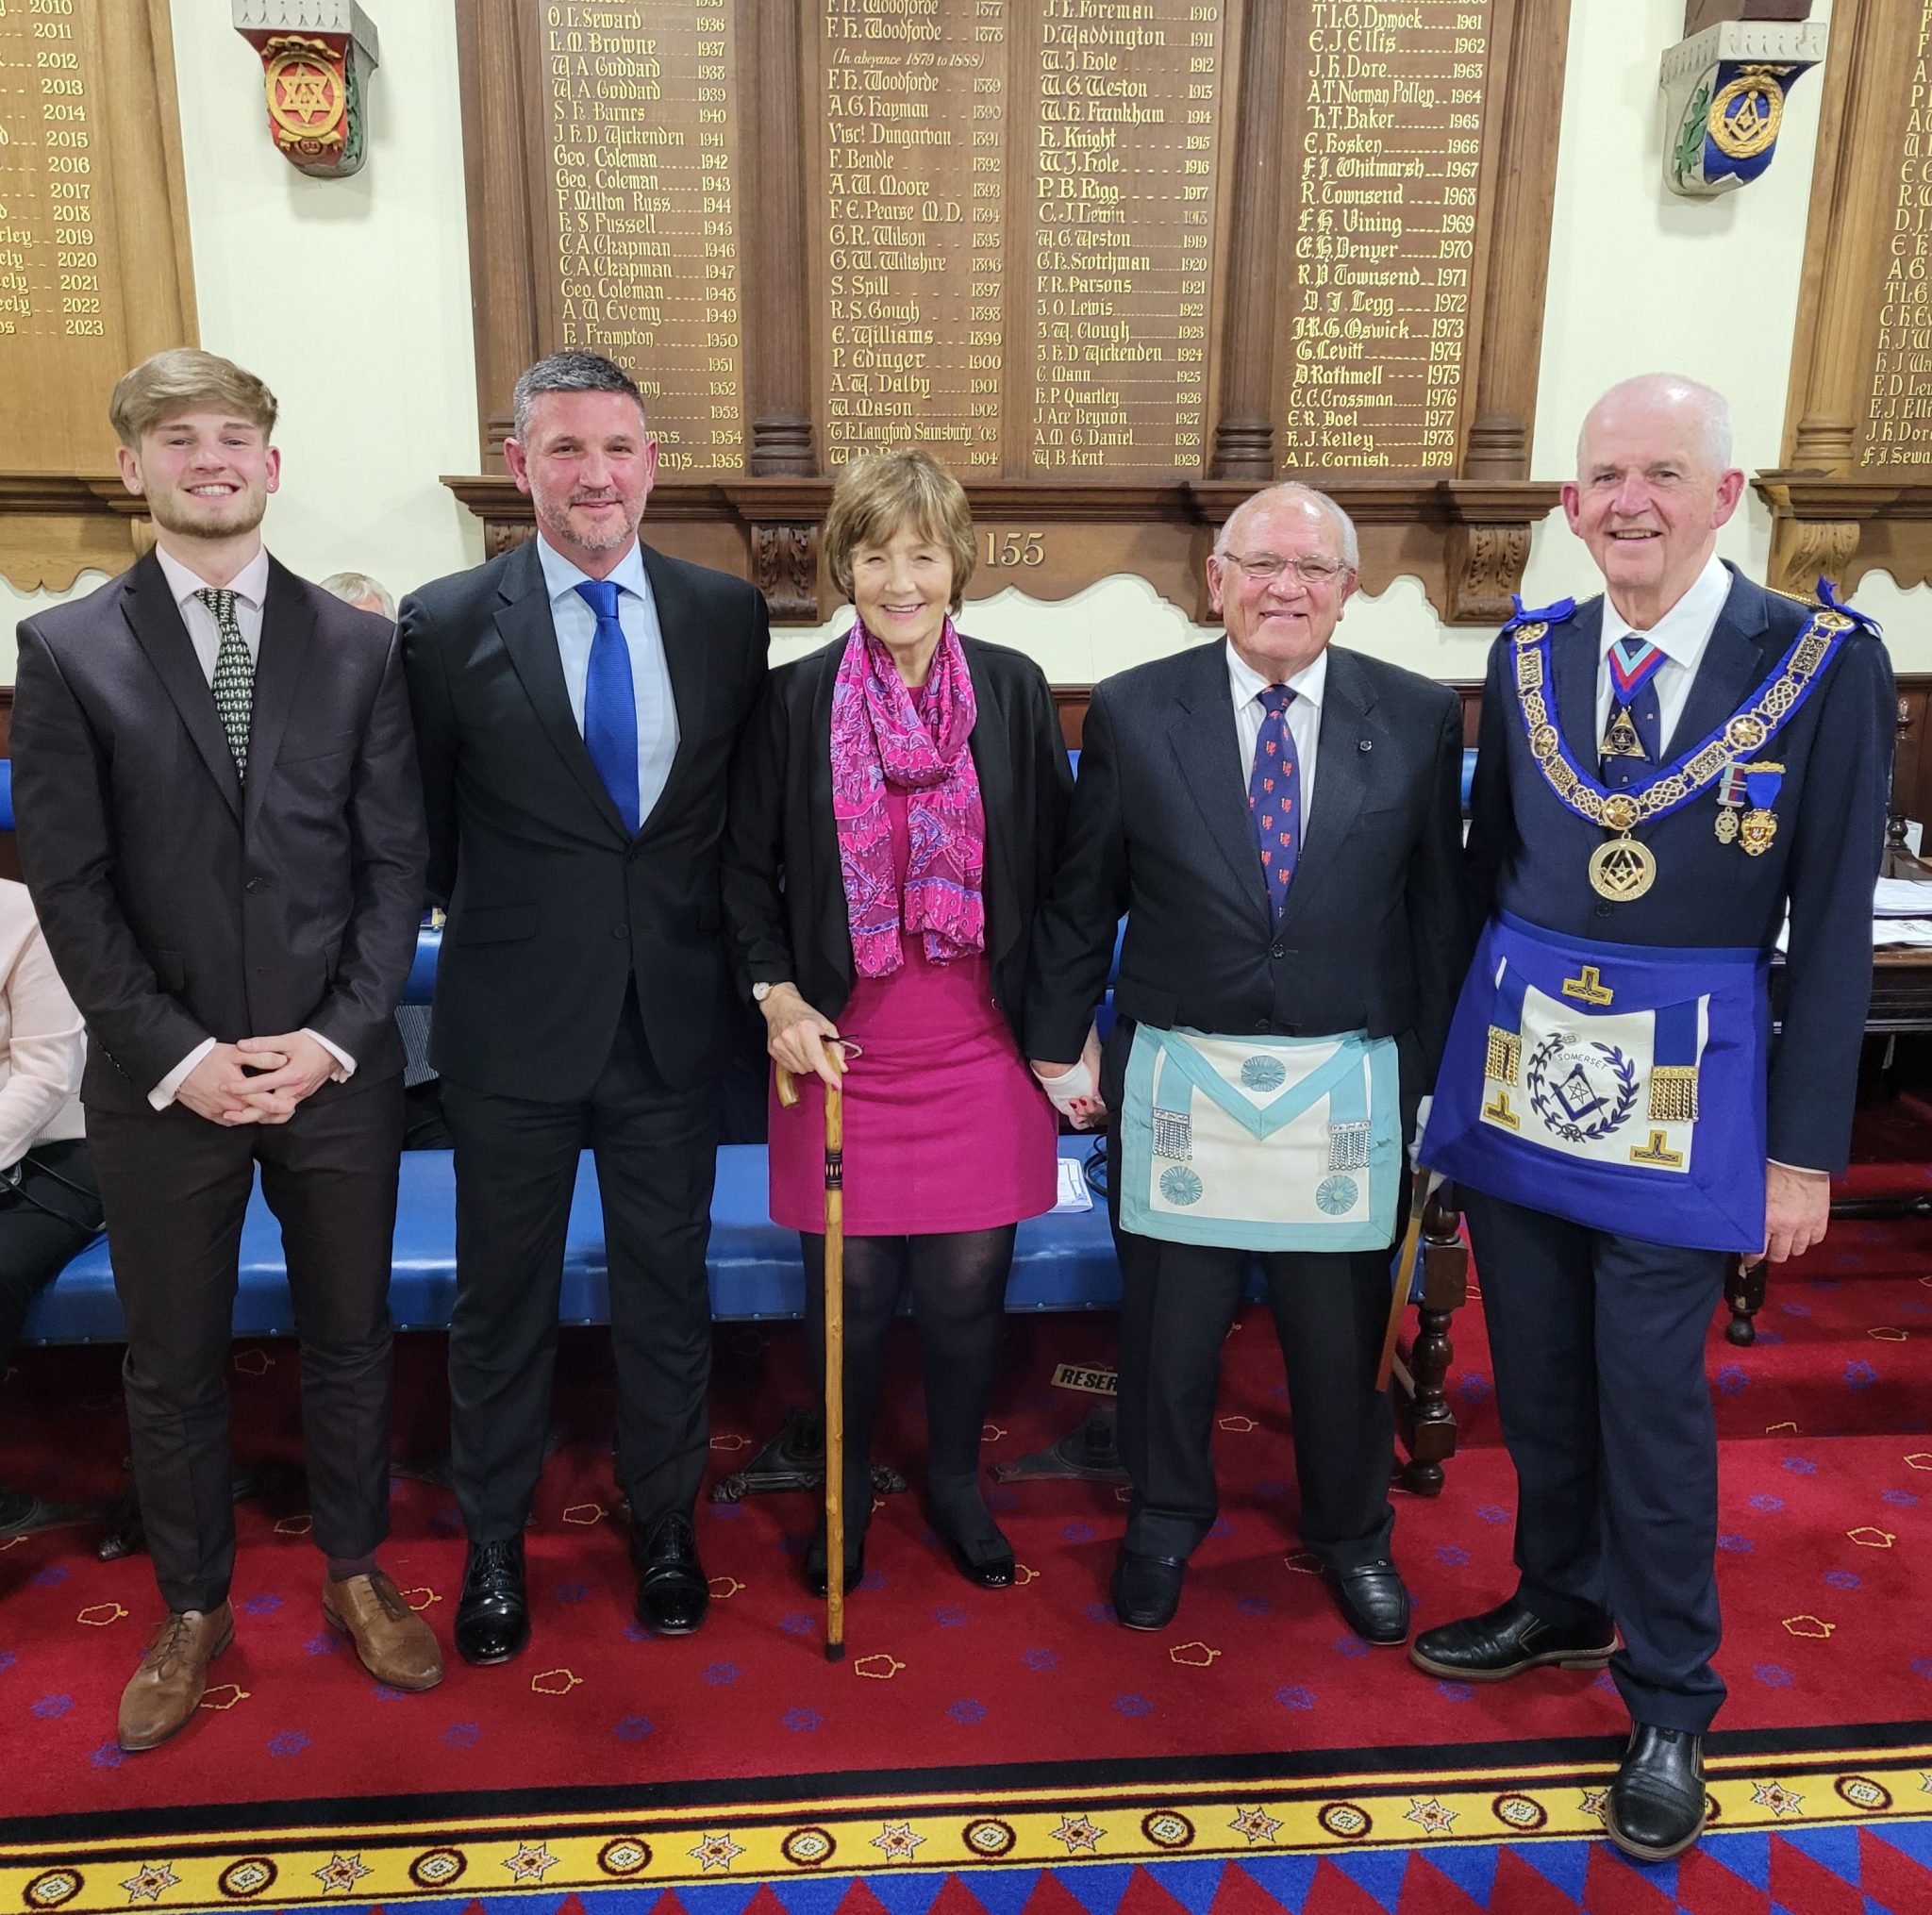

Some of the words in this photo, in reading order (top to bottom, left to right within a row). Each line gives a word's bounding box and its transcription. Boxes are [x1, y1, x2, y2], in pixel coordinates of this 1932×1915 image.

[30, 0, 73, 15] 2010
[975, 2, 1003, 16] 1877
[1190, 7, 1217, 21] 1910
[696, 18, 724, 31] 1936
[1456, 15, 1482, 29] 1961
[34, 24, 73, 39] 2011
[865, 18, 941, 43] Woodforde
[975, 26, 1003, 42] 1878
[1191, 33, 1213, 46] 1911
[1454, 39, 1485, 53] 1962
[697, 42, 725, 57] 1937
[37, 53, 78, 69] 2012
[855, 50, 901, 68] abeyance
[907, 53, 934, 65] 1879
[938, 56, 946, 65] to
[1190, 58, 1214, 73] 1912
[595, 57, 660, 77] Goddard
[698, 66, 725, 79] 1938
[1453, 64, 1483, 78] 1963
[42, 79, 84, 94] 2013
[864, 70, 939, 94] Woodforde
[974, 78, 1001, 92] 1889
[1086, 75, 1147, 97] Weston
[1189, 85, 1213, 99] 1913
[698, 88, 726, 102] 1939
[1451, 90, 1481, 104] 1964
[43, 105, 85, 121] 2014
[593, 102, 645, 121] Barnes
[699, 109, 726, 124] 1940
[973, 106, 1001, 119] 1890
[1088, 102, 1164, 127] Frankham
[1188, 111, 1211, 124] 1914
[1449, 114, 1479, 129] 1965
[46, 131, 88, 147] 2015
[605, 125, 684, 149] Wickenden
[700, 133, 724, 147] 1941
[973, 132, 999, 145] 1891
[1064, 126, 1117, 153] Knight
[1186, 136, 1210, 149] 1915
[1447, 140, 1478, 154] 1966
[554, 145, 590, 168] Geo.
[594, 146, 658, 168] Coleman
[701, 155, 728, 169] 1942
[846, 149, 894, 170] Bendle
[973, 158, 1000, 172] 1892
[49, 157, 90, 174] 2016
[1185, 160, 1209, 175] 1916
[1337, 158, 1424, 178] Whitmarsh
[1446, 162, 1478, 177] 1967
[557, 169, 591, 190] Geo.
[596, 169, 658, 190] Coleman
[702, 177, 731, 191] 1943
[880, 175, 929, 196] Moore
[973, 183, 1000, 197] 1893
[50, 183, 90, 199] 2017
[1080, 178, 1120, 204] Rigg
[1184, 186, 1208, 200] 1917
[1323, 181, 1404, 205] Townsend
[1443, 188, 1476, 205] 1968
[633, 192, 671, 212] Russ
[704, 198, 731, 213] 1944
[54, 206, 91, 221] 2018
[865, 201, 913, 220] Pearse
[973, 208, 1000, 223] 1894
[1184, 210, 1208, 225] 1918
[595, 213, 656, 234] Fussell
[704, 222, 733, 235] 1945
[1342, 208, 1402, 237] Vining
[1442, 215, 1474, 233] 1969
[56, 229, 93, 244] 2019
[873, 225, 925, 247] Wilson
[972, 229, 1000, 248] 1895
[1184, 236, 1208, 249] 1919
[705, 243, 735, 258] 1946
[1439, 240, 1473, 258] 1970
[58, 253, 97, 267] 2020
[879, 252, 946, 274] Wiltshire
[972, 258, 1001, 273] 1896
[1181, 258, 1208, 272] 1920
[706, 264, 735, 279] 1947
[1335, 264, 1420, 286] Townsend
[1437, 269, 1467, 287] 1971
[60, 275, 99, 291] 2021
[561, 278, 594, 299] Geo.
[599, 278, 664, 299] Coleman
[707, 288, 736, 301] 1948
[852, 275, 889, 297] Spill
[972, 283, 1001, 297] 1897
[1182, 281, 1206, 293] 1921
[63, 298, 101, 313] 2022
[1071, 299, 1113, 315] Lewis
[1179, 304, 1204, 316] 1922
[1351, 291, 1394, 316] Legg
[1434, 294, 1467, 312] 1972
[707, 308, 737, 323] 1949
[971, 307, 1001, 321] 1898
[66, 320, 104, 335] 2023
[587, 324, 654, 346] Frampton
[708, 334, 738, 347] 1950
[852, 325, 934, 346] Williams
[969, 332, 1002, 345] 1899
[1077, 321, 1130, 343] Clough
[1178, 326, 1205, 339] 1923
[1432, 319, 1464, 338] 1973
[1084, 343, 1162, 366] Wickenden
[1177, 348, 1203, 362] 1924
[1430, 341, 1461, 361] 1974
[708, 358, 734, 372] 1951
[853, 350, 925, 373] Edinger
[969, 355, 1002, 370] 1900
[1053, 367, 1091, 382] Mann
[1177, 372, 1201, 383] 1925
[1427, 365, 1460, 385] 1975
[709, 382, 736, 395] 1952
[875, 374, 930, 399] Dalby
[971, 379, 998, 393] 1901
[1064, 387, 1120, 408] Quartley
[1176, 392, 1201, 404] 1926
[1426, 390, 1457, 407] 1976
[710, 406, 739, 420] 1953
[971, 403, 998, 416] 1902
[1075, 408, 1127, 427] Beynon
[1175, 413, 1200, 425] 1927
[1424, 410, 1455, 427] 1977
[711, 429, 742, 444] 1954
[914, 423, 973, 445] Sainsbury
[1089, 429, 1134, 445] Daniel
[1175, 433, 1200, 445] 1928
[1321, 431, 1374, 452] Kelley
[1423, 430, 1455, 446] 1978
[711, 454, 743, 468] 1955
[971, 452, 998, 465] 1904
[1071, 450, 1105, 465] Kent
[1174, 455, 1200, 466] 1929
[1322, 452, 1389, 467] Cornish
[1422, 452, 1453, 467] 1979
[987, 532, 1044, 565] 155
[1557, 1053, 1608, 1071] SOMERSET
[1060, 1368, 1117, 1391] RESER
